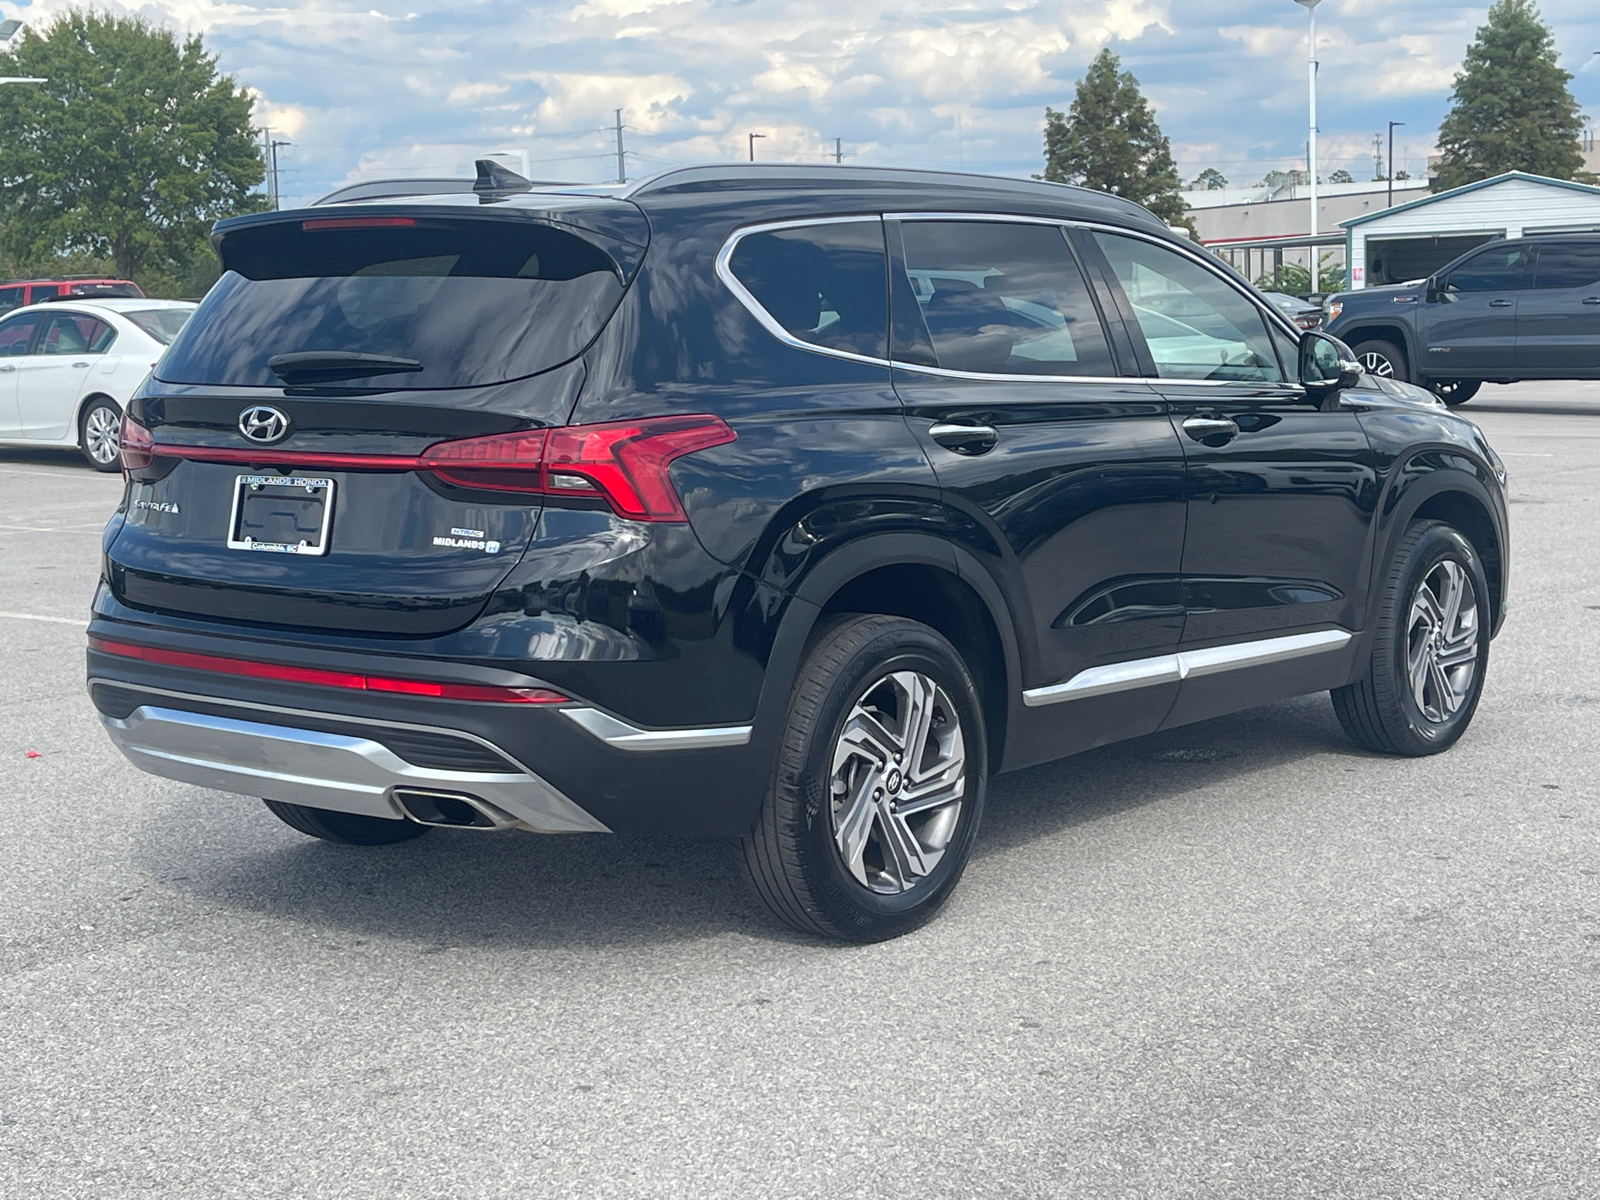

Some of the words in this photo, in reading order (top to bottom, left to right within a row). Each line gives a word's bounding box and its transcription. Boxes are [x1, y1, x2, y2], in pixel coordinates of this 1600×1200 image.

[247, 476, 291, 485] MIDLANDS
[294, 478, 327, 486] HONDA
[432, 536, 486, 550] MIDLANDS
